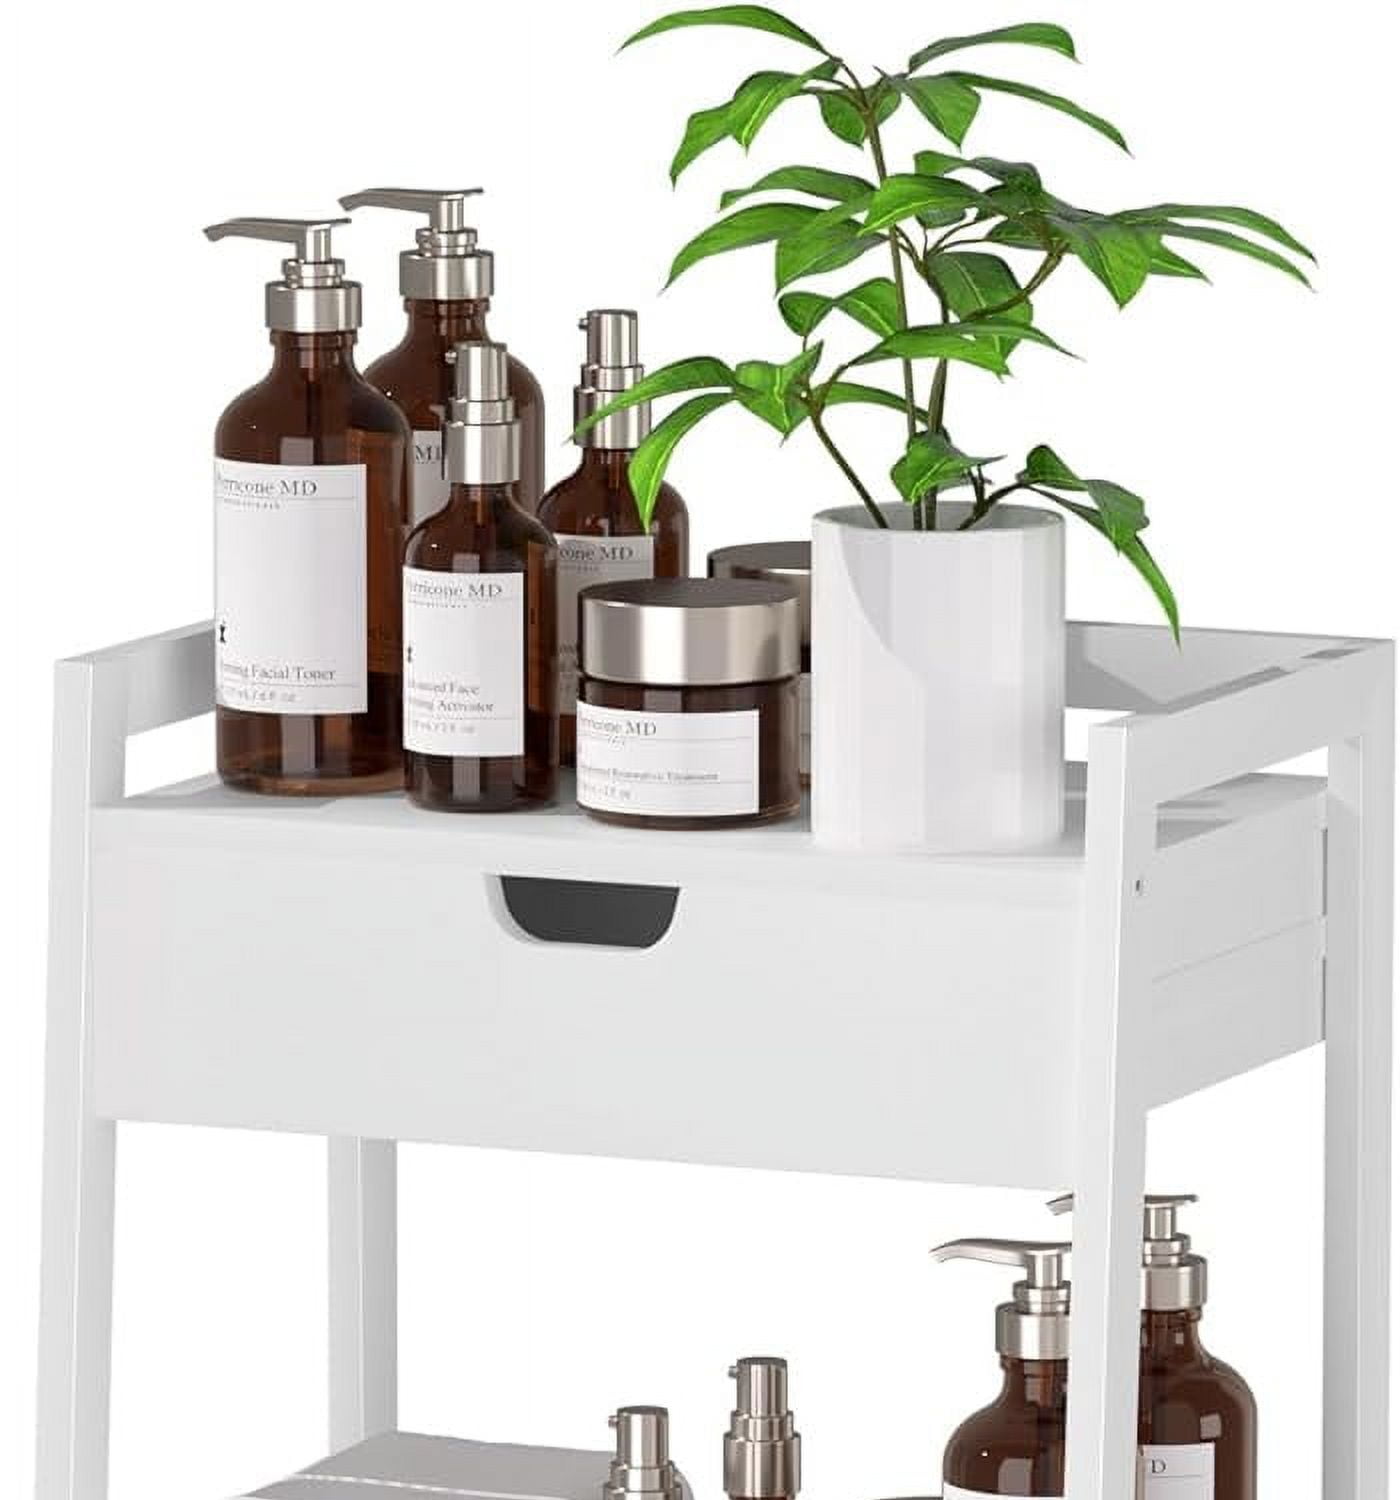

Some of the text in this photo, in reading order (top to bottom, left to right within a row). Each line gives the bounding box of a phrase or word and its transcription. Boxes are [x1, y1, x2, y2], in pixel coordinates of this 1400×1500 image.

[279, 479, 318, 496] MD
[600, 546, 634, 560] MD
[468, 583, 502, 598] MD
[292, 665, 337, 682] Toner
[626, 719, 657, 736] MD
